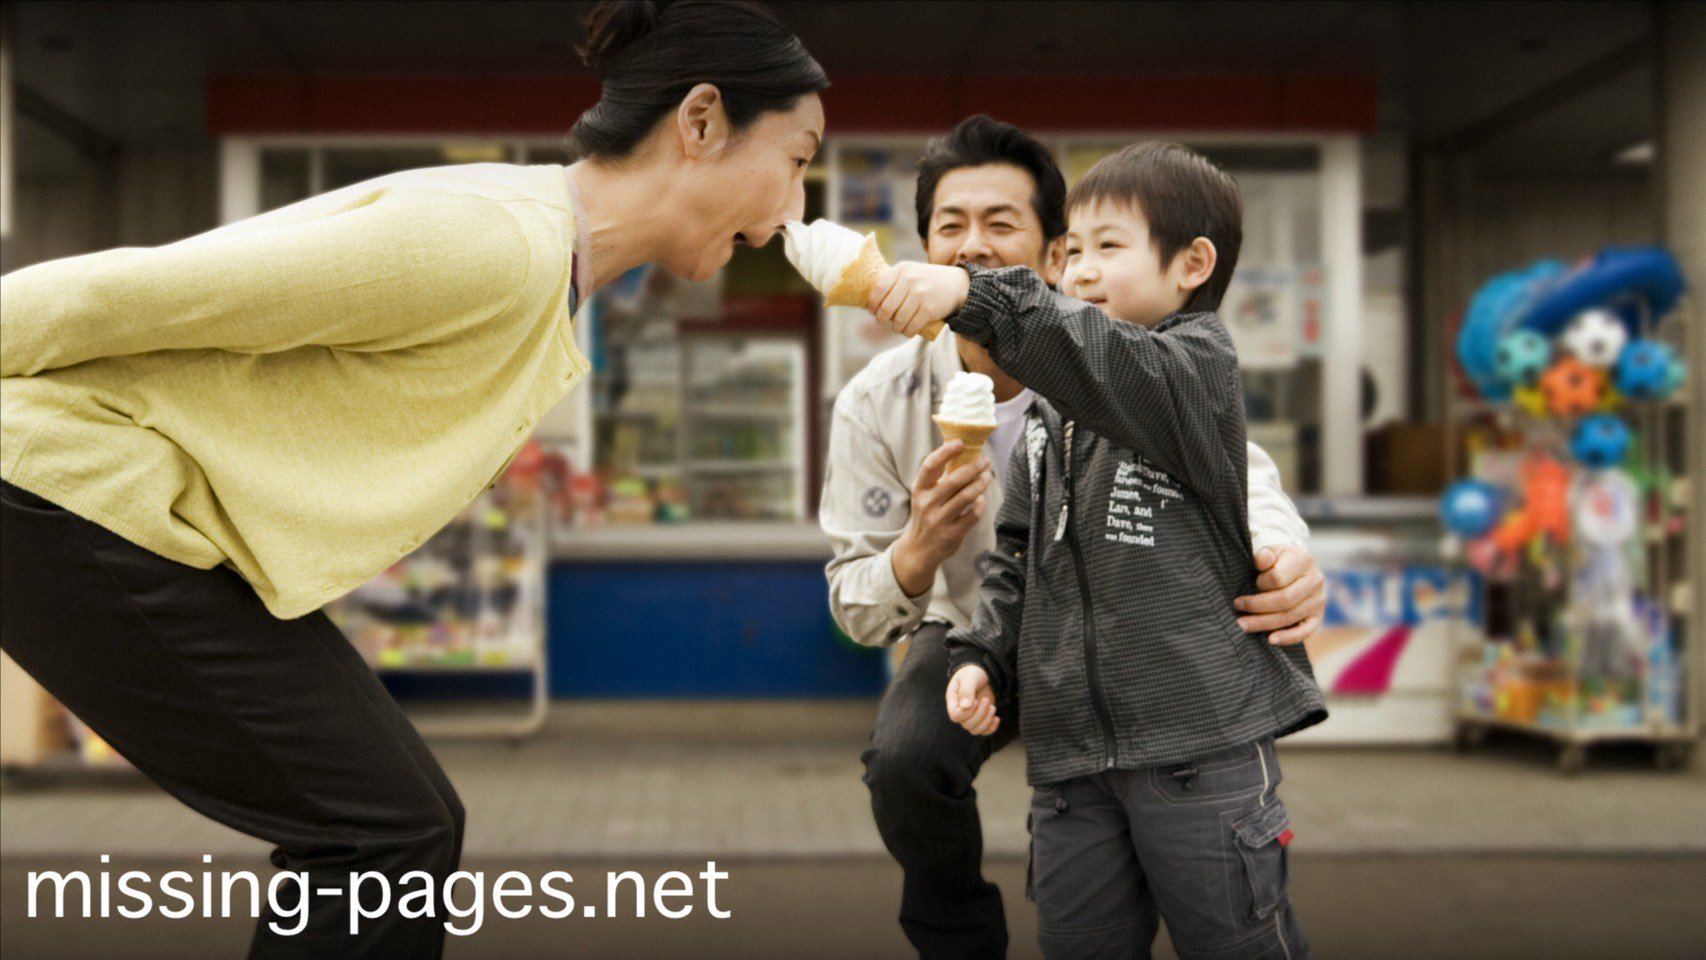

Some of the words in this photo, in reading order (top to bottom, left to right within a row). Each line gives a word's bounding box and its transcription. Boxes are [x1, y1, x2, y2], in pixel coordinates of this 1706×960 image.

[1134, 506, 1153, 518] and
[1107, 515, 1133, 531] Dave,
[1119, 532, 1155, 547] founded
